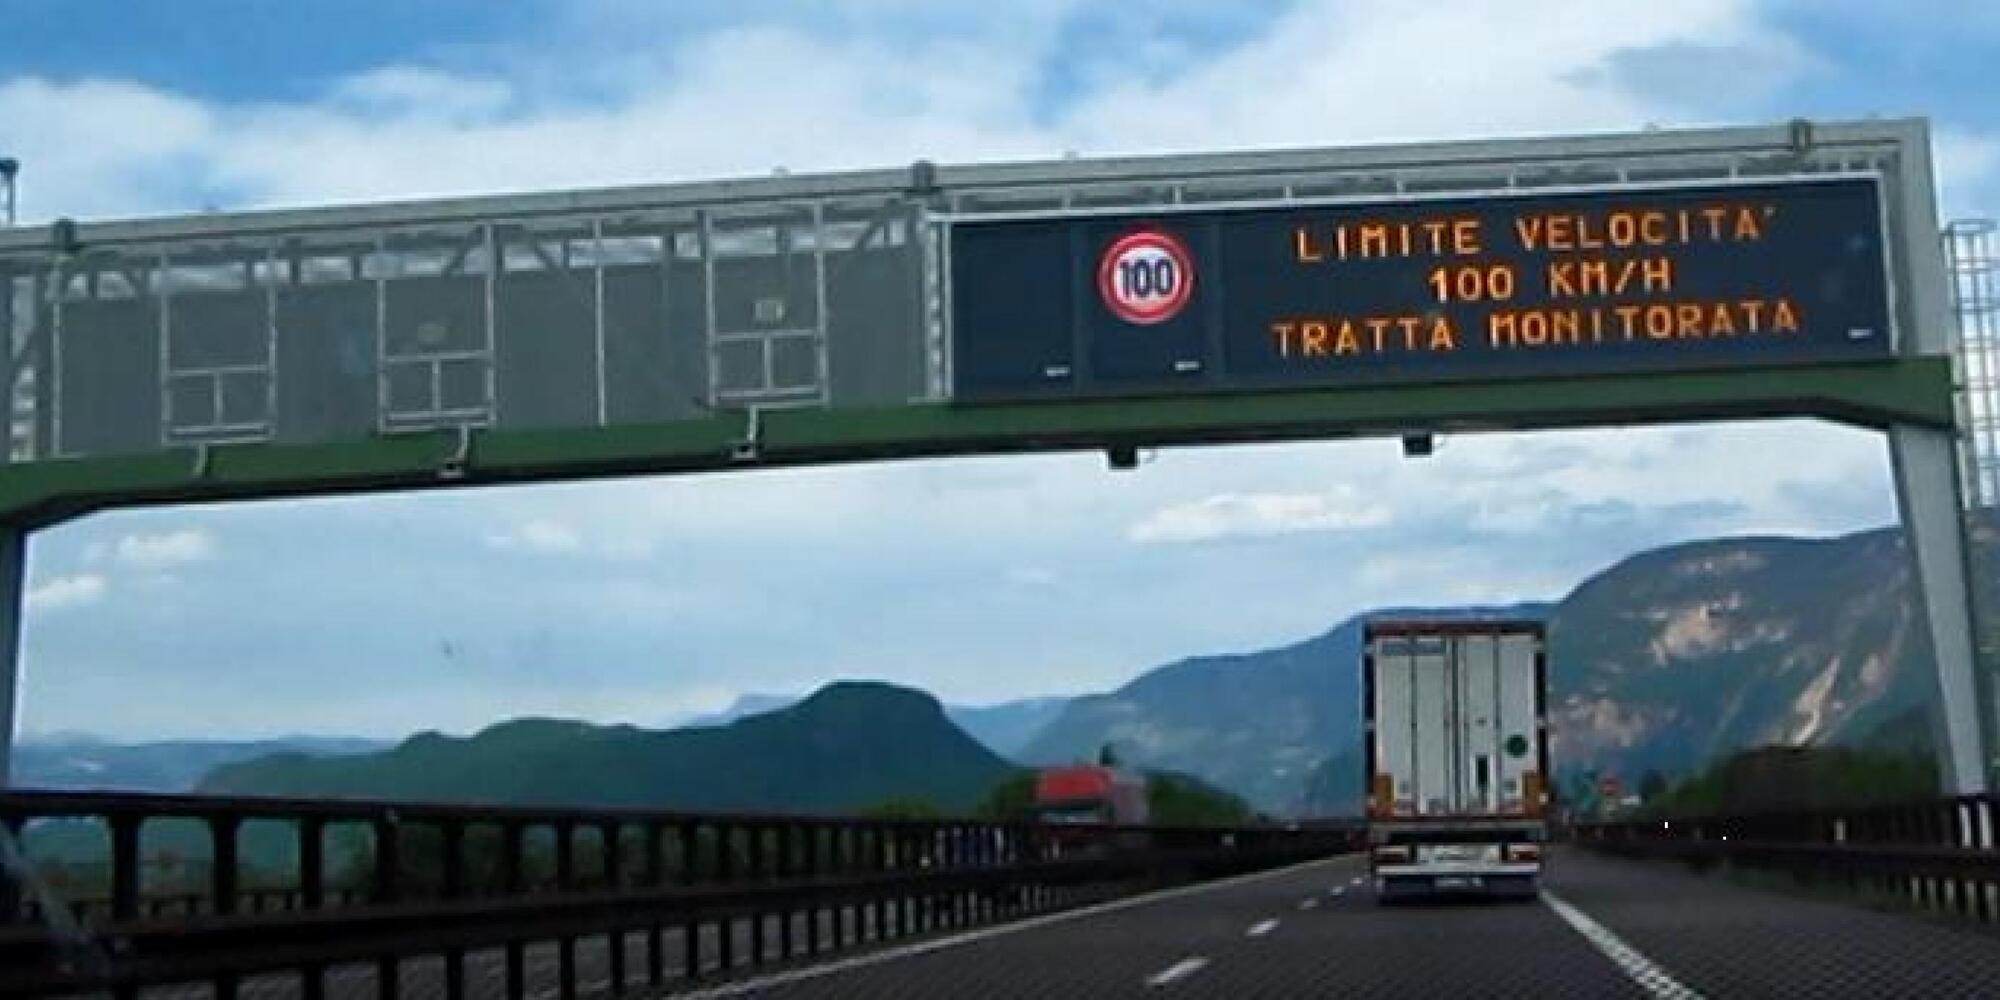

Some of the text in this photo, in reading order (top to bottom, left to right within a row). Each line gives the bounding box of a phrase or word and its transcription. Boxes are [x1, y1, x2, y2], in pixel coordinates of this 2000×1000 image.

[1297, 219, 1481, 262] LIMITE
[1119, 258, 1173, 299] 100
[1429, 256, 1673, 303] 100 KM/H
[1271, 300, 1798, 357] TRATTA MONITORATA
